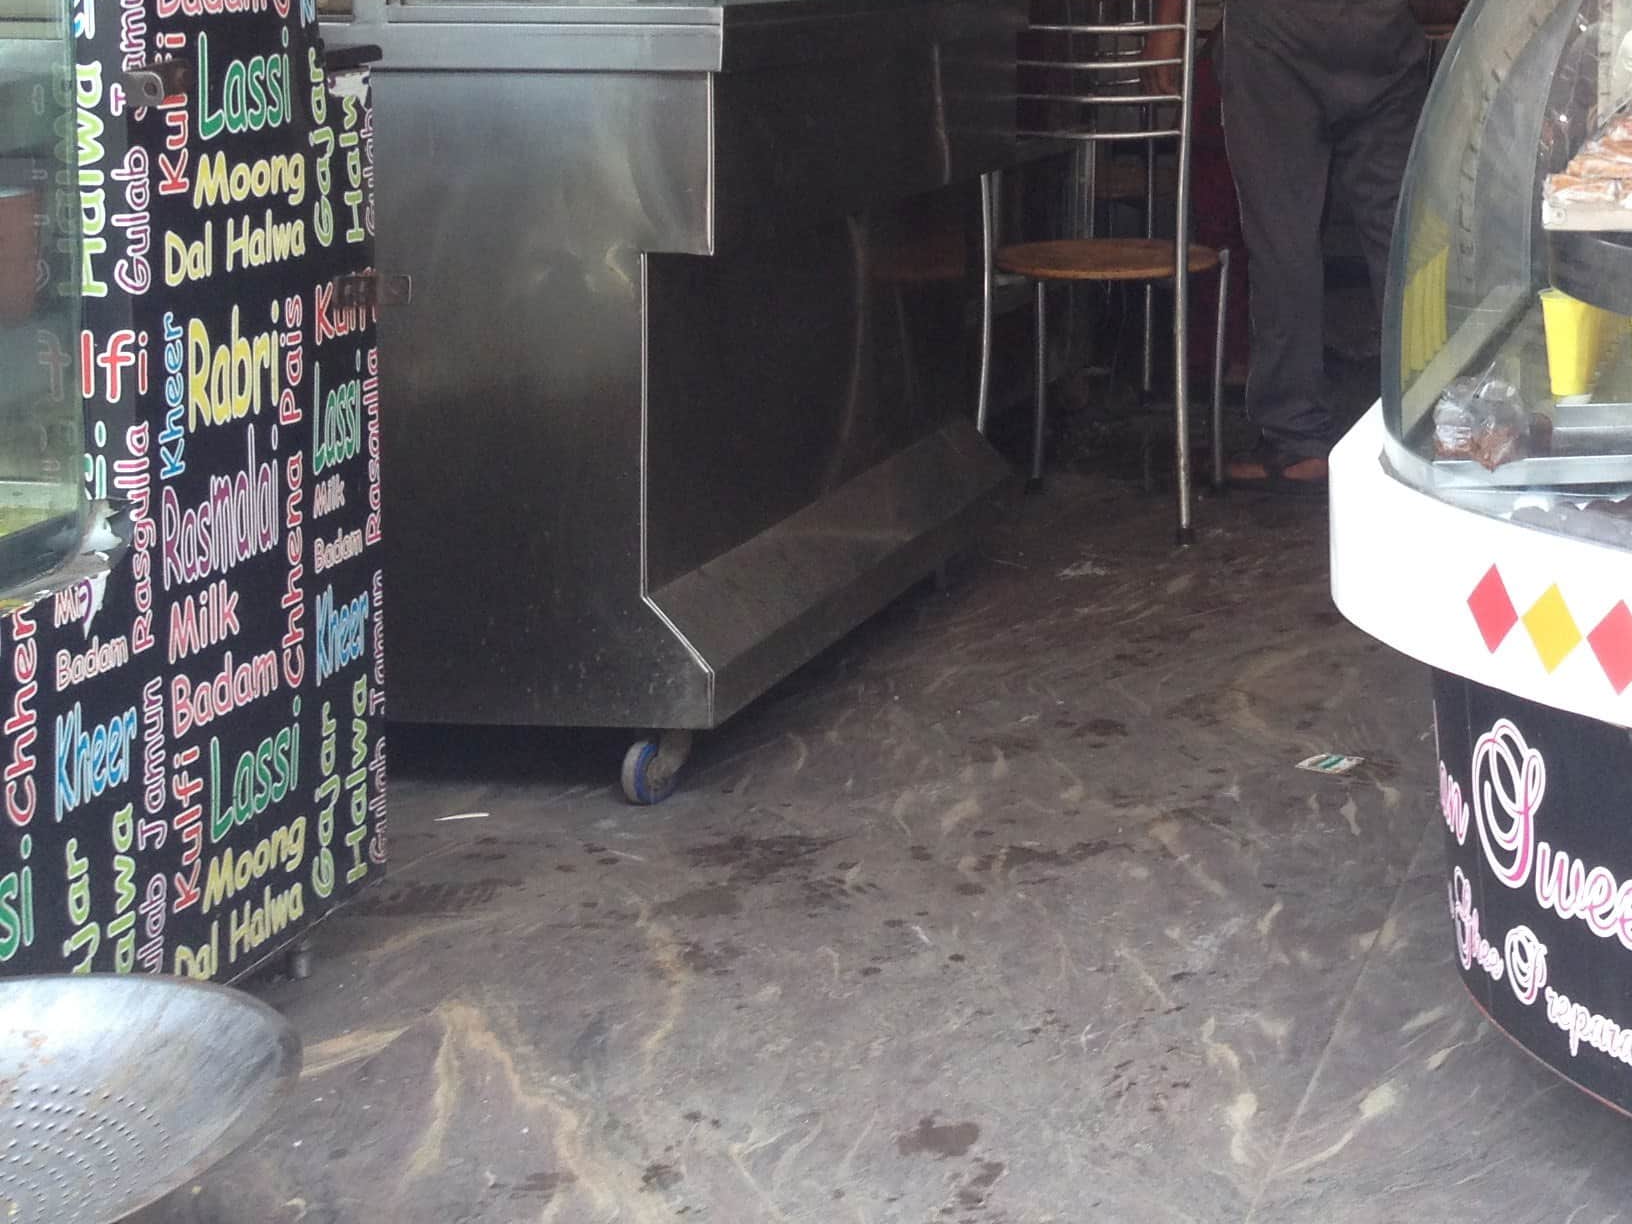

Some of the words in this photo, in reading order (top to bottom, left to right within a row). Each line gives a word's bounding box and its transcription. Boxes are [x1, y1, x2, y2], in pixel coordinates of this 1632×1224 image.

[198, 26, 292, 141] Lassi
[308, 46, 335, 248] Gajar
[110, 145, 151, 295] Gulab
[193, 150, 306, 210] Moong
[165, 220, 212, 287] Dal
[226, 208, 306, 273] Halwa
[159, 312, 184, 480] Kheer
[188, 299, 280, 434] Rabri
[279, 294, 303, 426] Pais
[312, 348, 361, 476] Lassi
[113, 420, 157, 654] Rasgulla
[161, 422, 279, 590] Rasmalai
[313, 473, 346, 518] Milk
[313, 527, 363, 574] Badam
[168, 580, 240, 664] Milk
[281, 449, 304, 689] Chhena
[56, 635, 129, 692] Badam
[171, 648, 278, 740] Badam
[315, 584, 369, 687] Kheer
[54, 701, 137, 823] Kheer
[138, 676, 167, 850] Jamun
[209, 694, 302, 844] Lassi
[311, 700, 341, 898] Gajar
[346, 673, 369, 884] Halwa
[173, 746, 202, 914] Kulfi
[202, 816, 306, 914] Moong
[229, 882, 304, 963] Halwa
